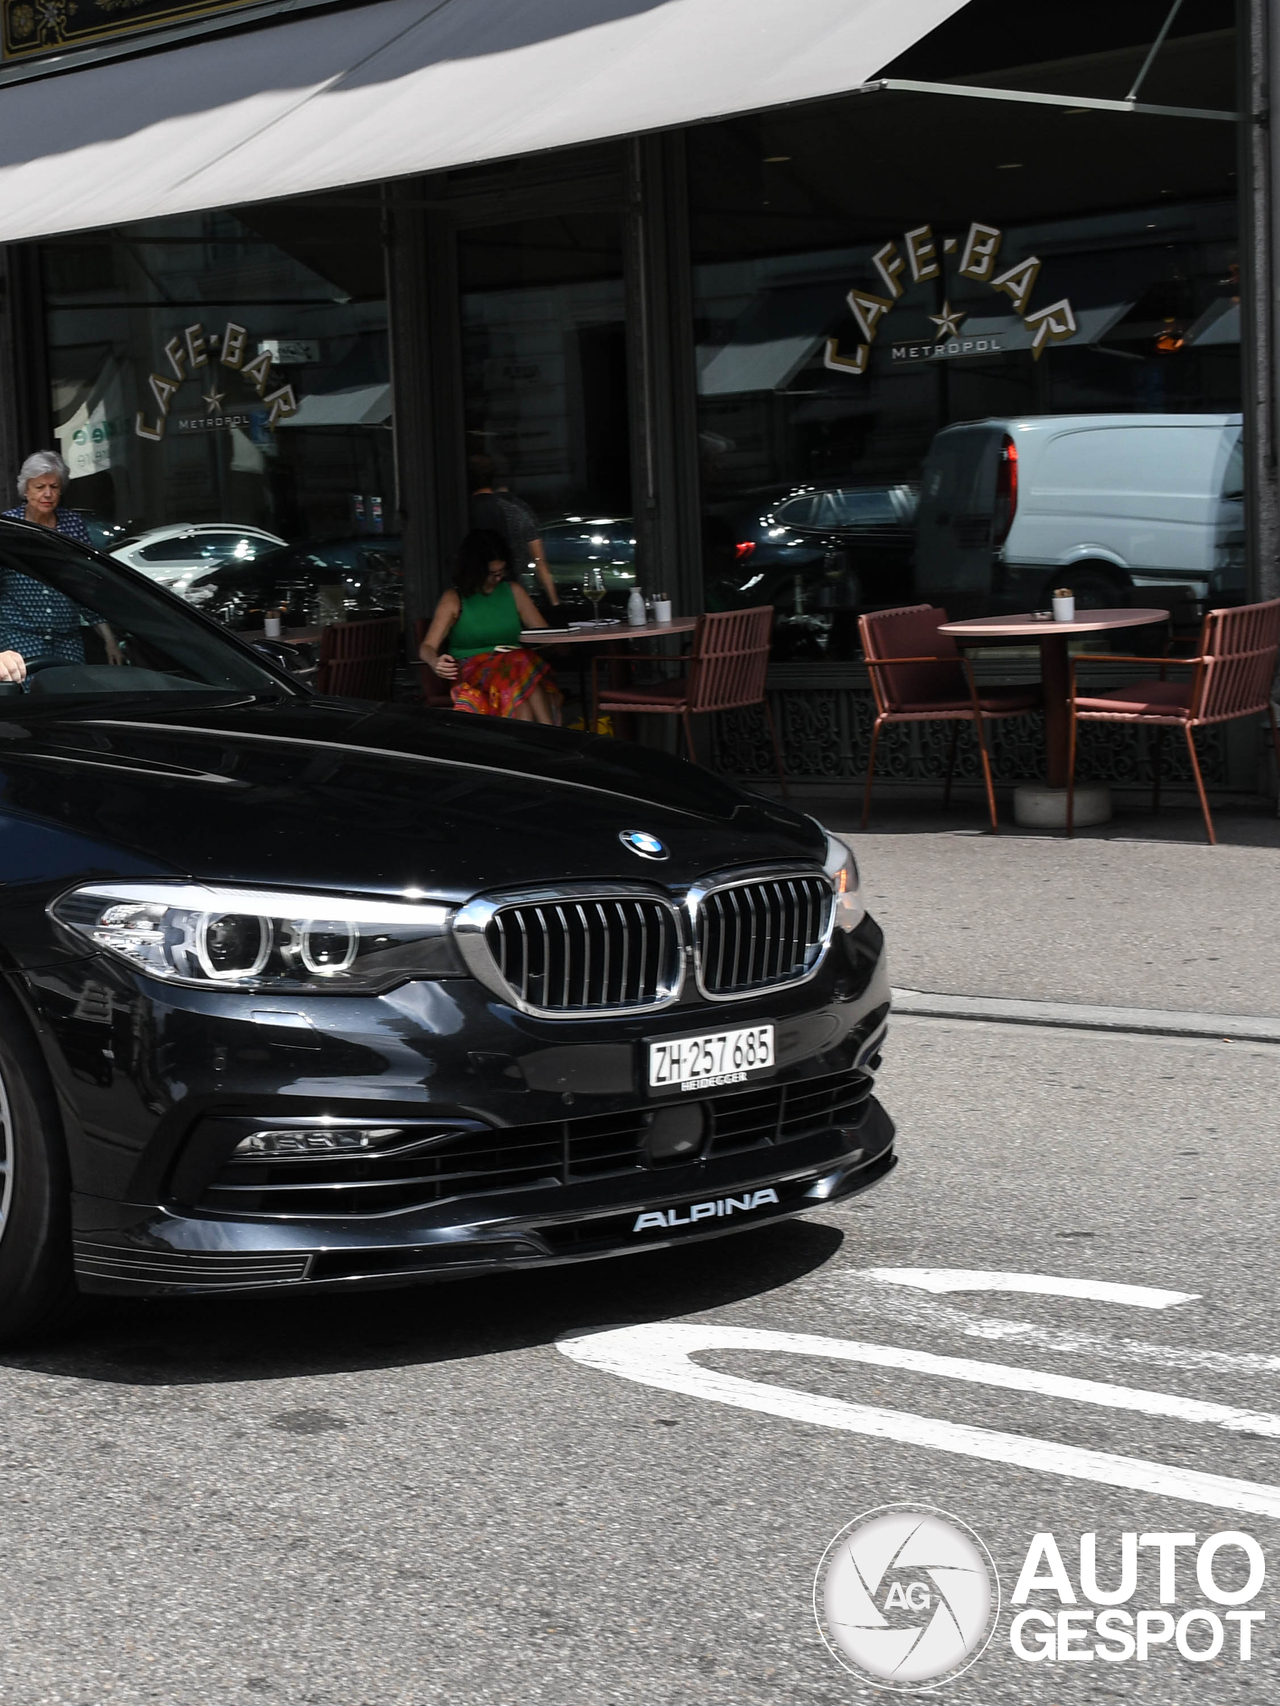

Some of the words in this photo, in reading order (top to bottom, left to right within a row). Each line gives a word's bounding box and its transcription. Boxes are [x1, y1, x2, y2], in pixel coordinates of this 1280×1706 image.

[891, 339, 1003, 360] METROPOL
[178, 415, 250, 430] METROPOL
[733, 1028, 769, 1069] 685
[681, 1072, 748, 1092] HEIDEGGER
[632, 1188, 780, 1232] ALPINA
